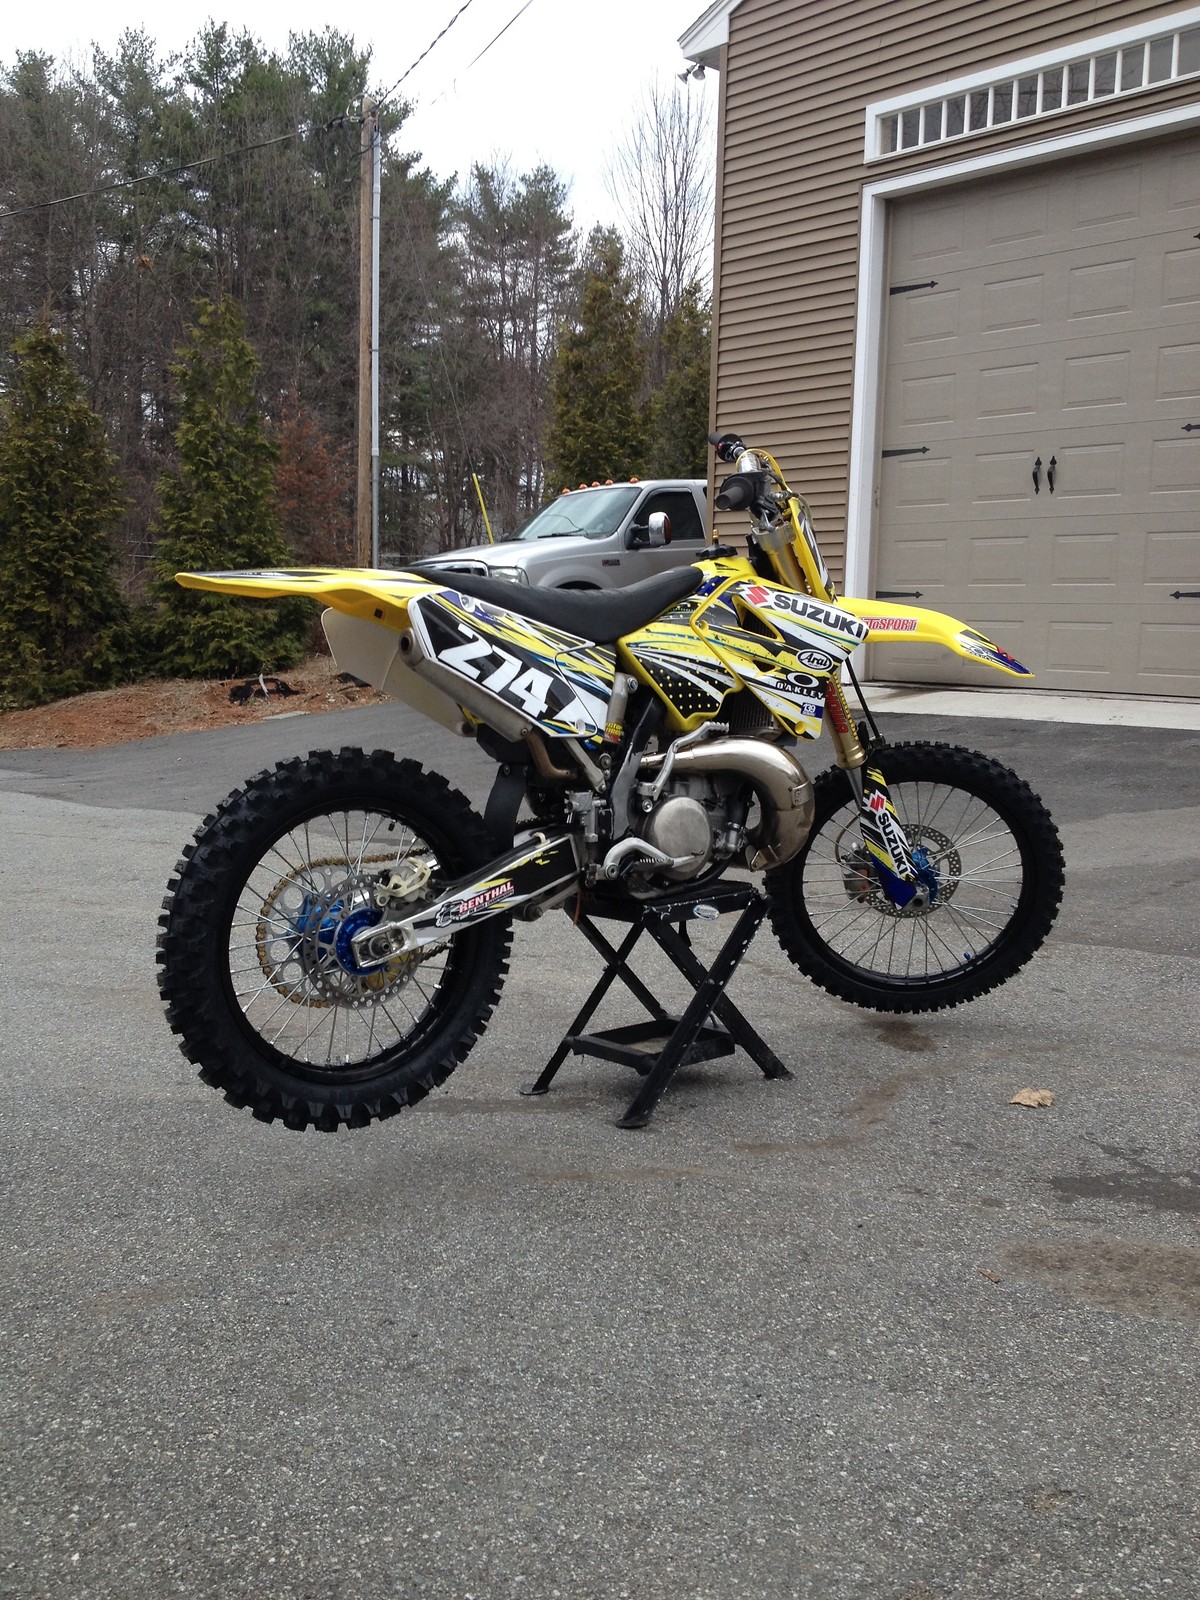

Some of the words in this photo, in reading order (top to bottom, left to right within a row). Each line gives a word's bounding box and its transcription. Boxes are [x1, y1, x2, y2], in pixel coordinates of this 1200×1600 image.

[773, 594, 864, 639] SUZUKI
[437, 622, 554, 718] 274
[800, 653, 828, 667] Arai
[776, 682, 824, 699] OAKLEY
[878, 812, 909, 876] SUZUKI
[459, 881, 515, 915] RENTHAL
